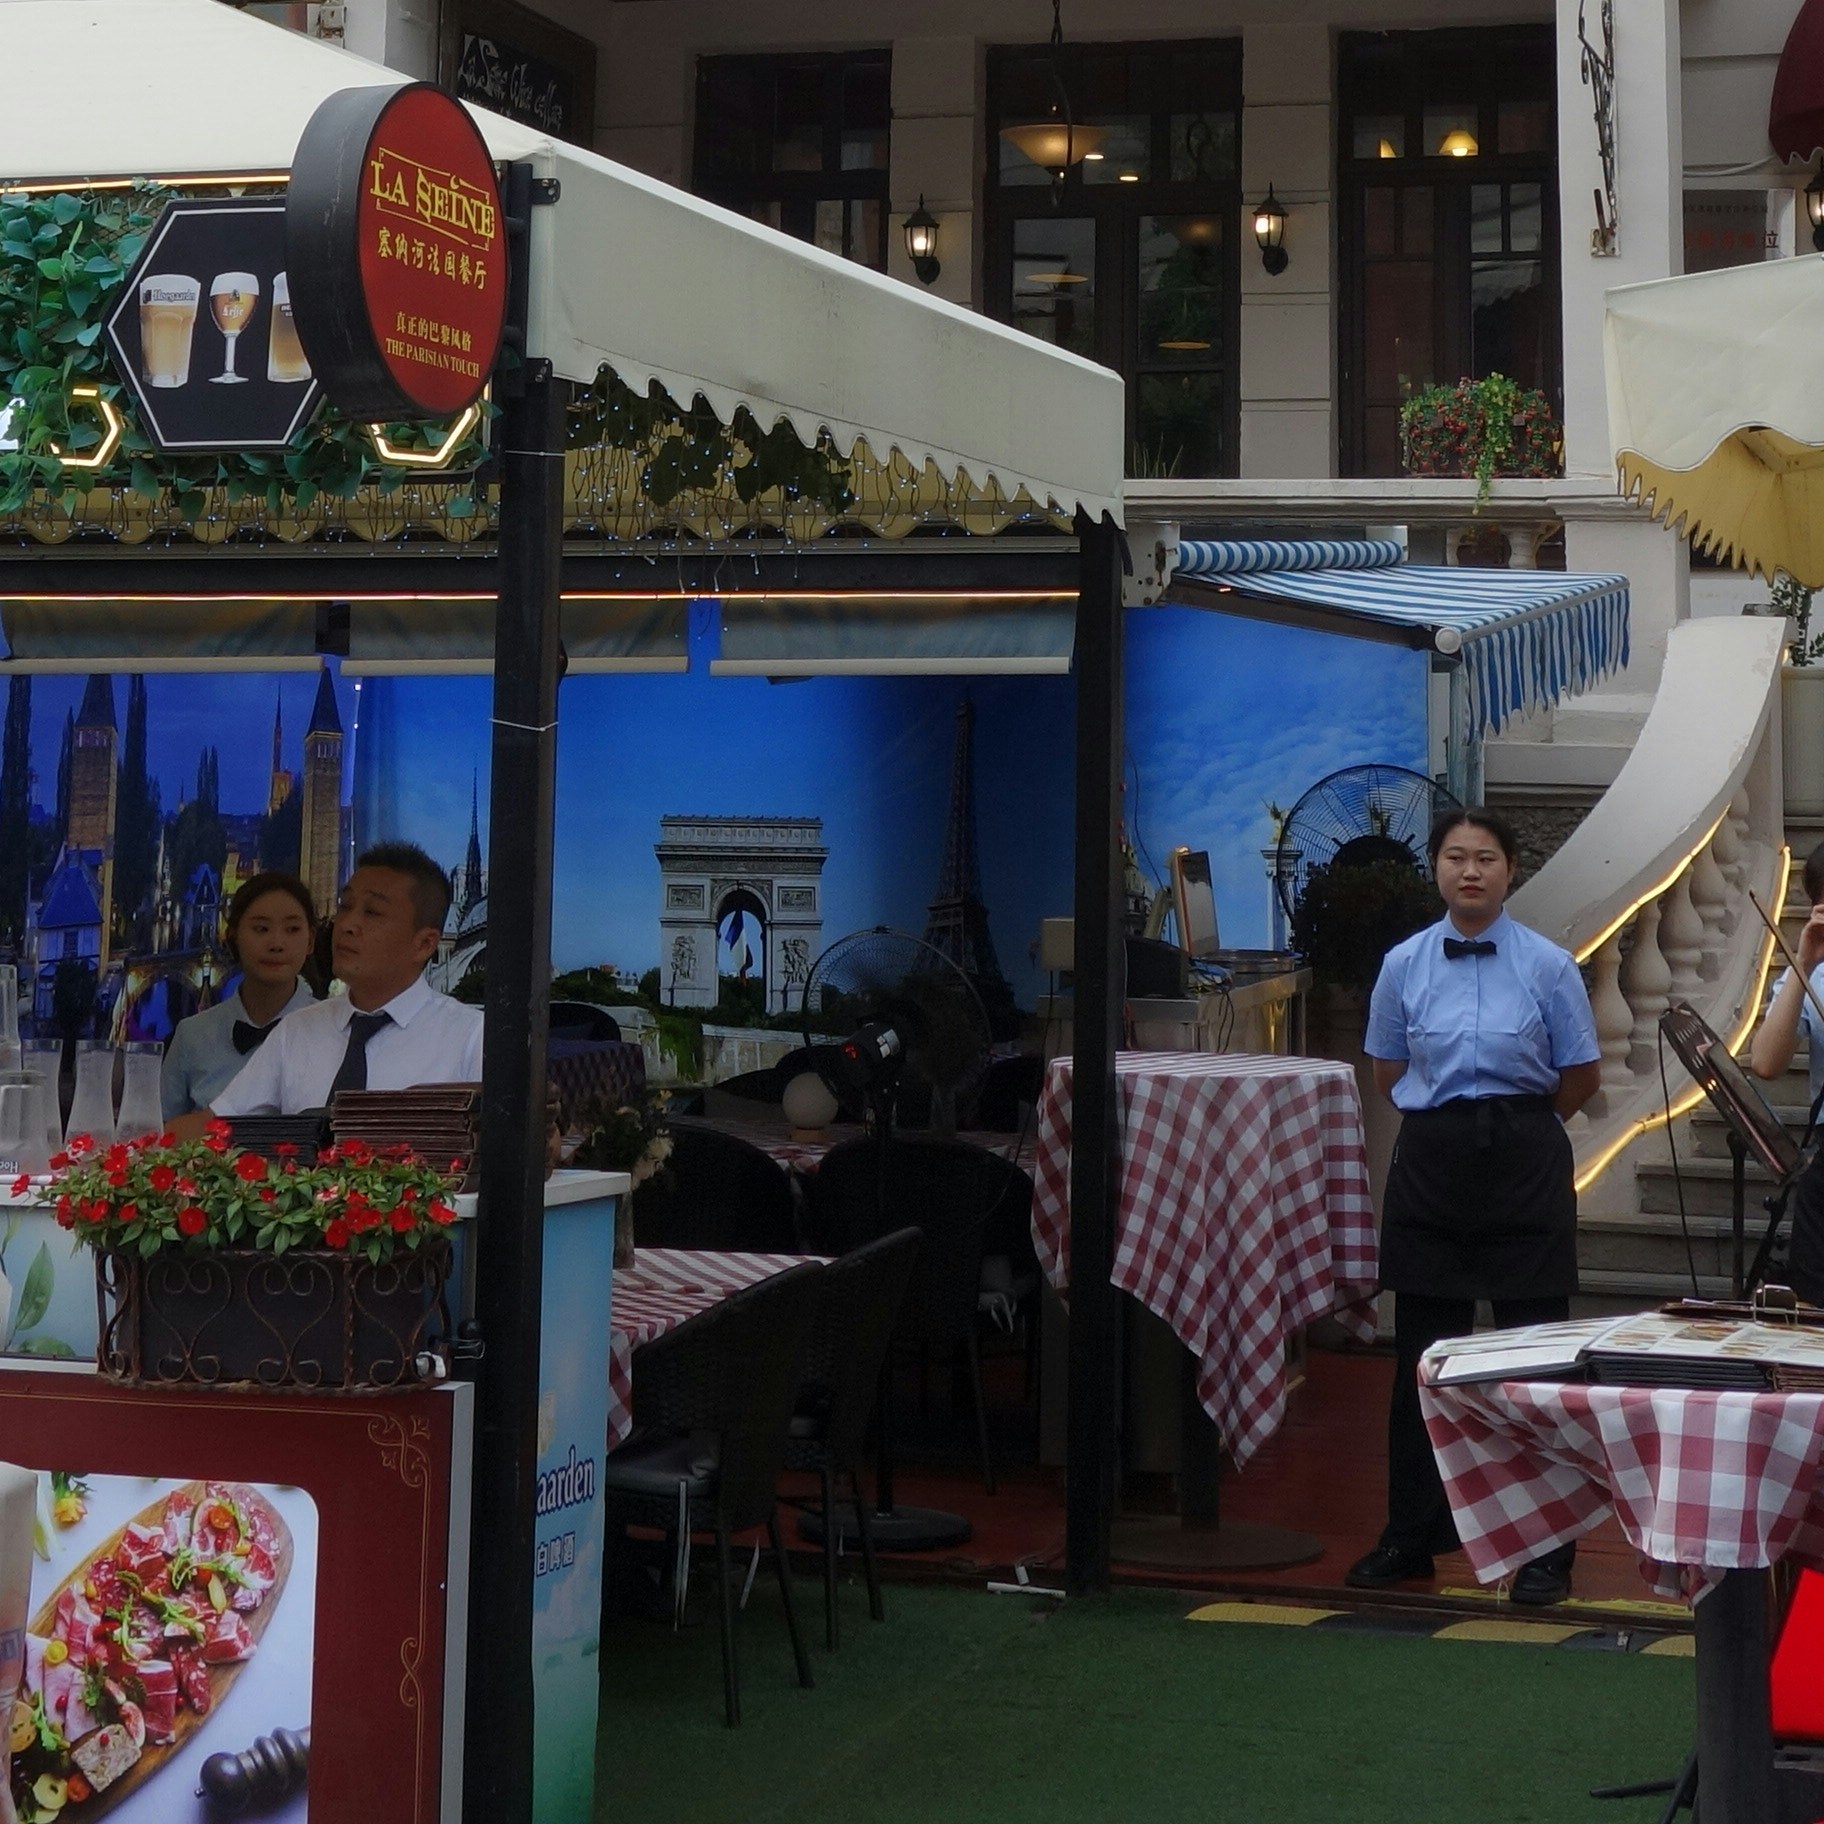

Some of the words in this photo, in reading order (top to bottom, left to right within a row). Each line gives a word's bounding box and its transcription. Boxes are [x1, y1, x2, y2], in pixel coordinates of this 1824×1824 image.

[370, 160, 409, 207] LA
[416, 167, 495, 239] SEINE
[377, 226, 487, 290] 塞纳河法国餐厅
[386, 338, 405, 358] THE
[406, 344, 449, 371] PARISIAN
[451, 358, 479, 379] TOUCH
[395, 311, 472, 353] 真正的巴黎风格
